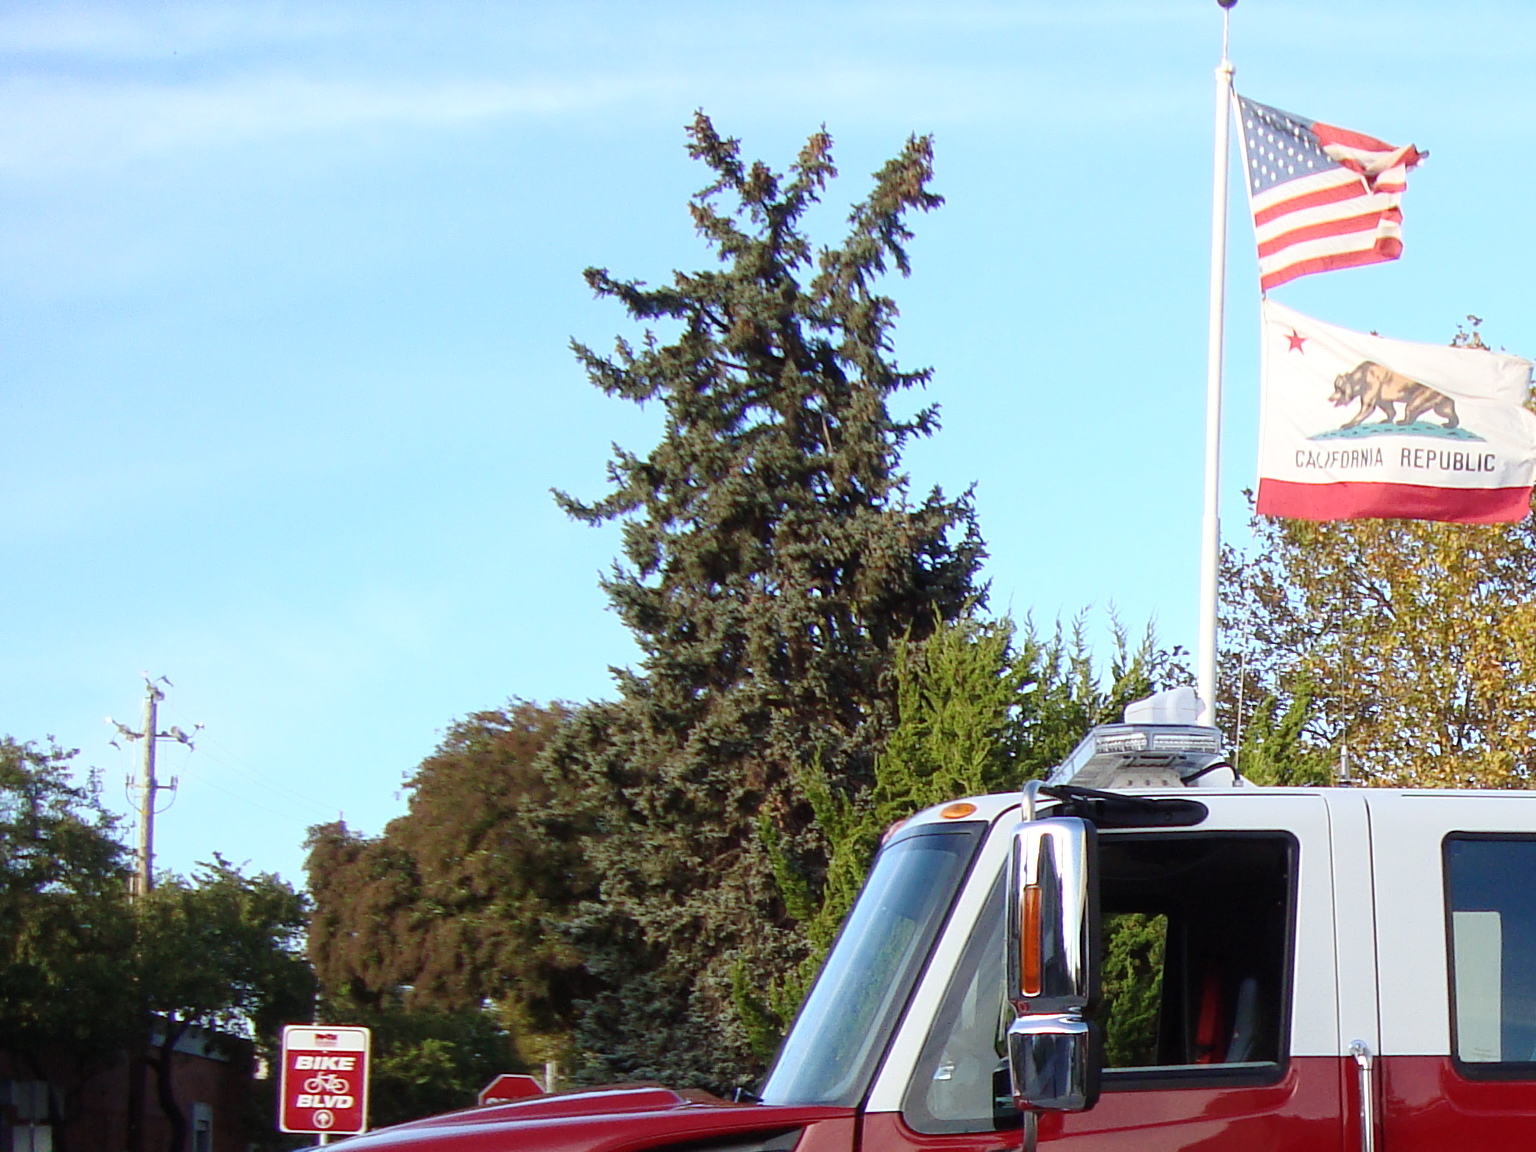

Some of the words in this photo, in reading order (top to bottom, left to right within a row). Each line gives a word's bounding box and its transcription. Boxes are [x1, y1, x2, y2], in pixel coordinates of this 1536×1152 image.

[1295, 447, 1384, 470] CALIFORNIA
[1400, 447, 1496, 473] REPUBLIC
[294, 1056, 357, 1071] BIKE
[295, 1094, 355, 1109] BLVD
